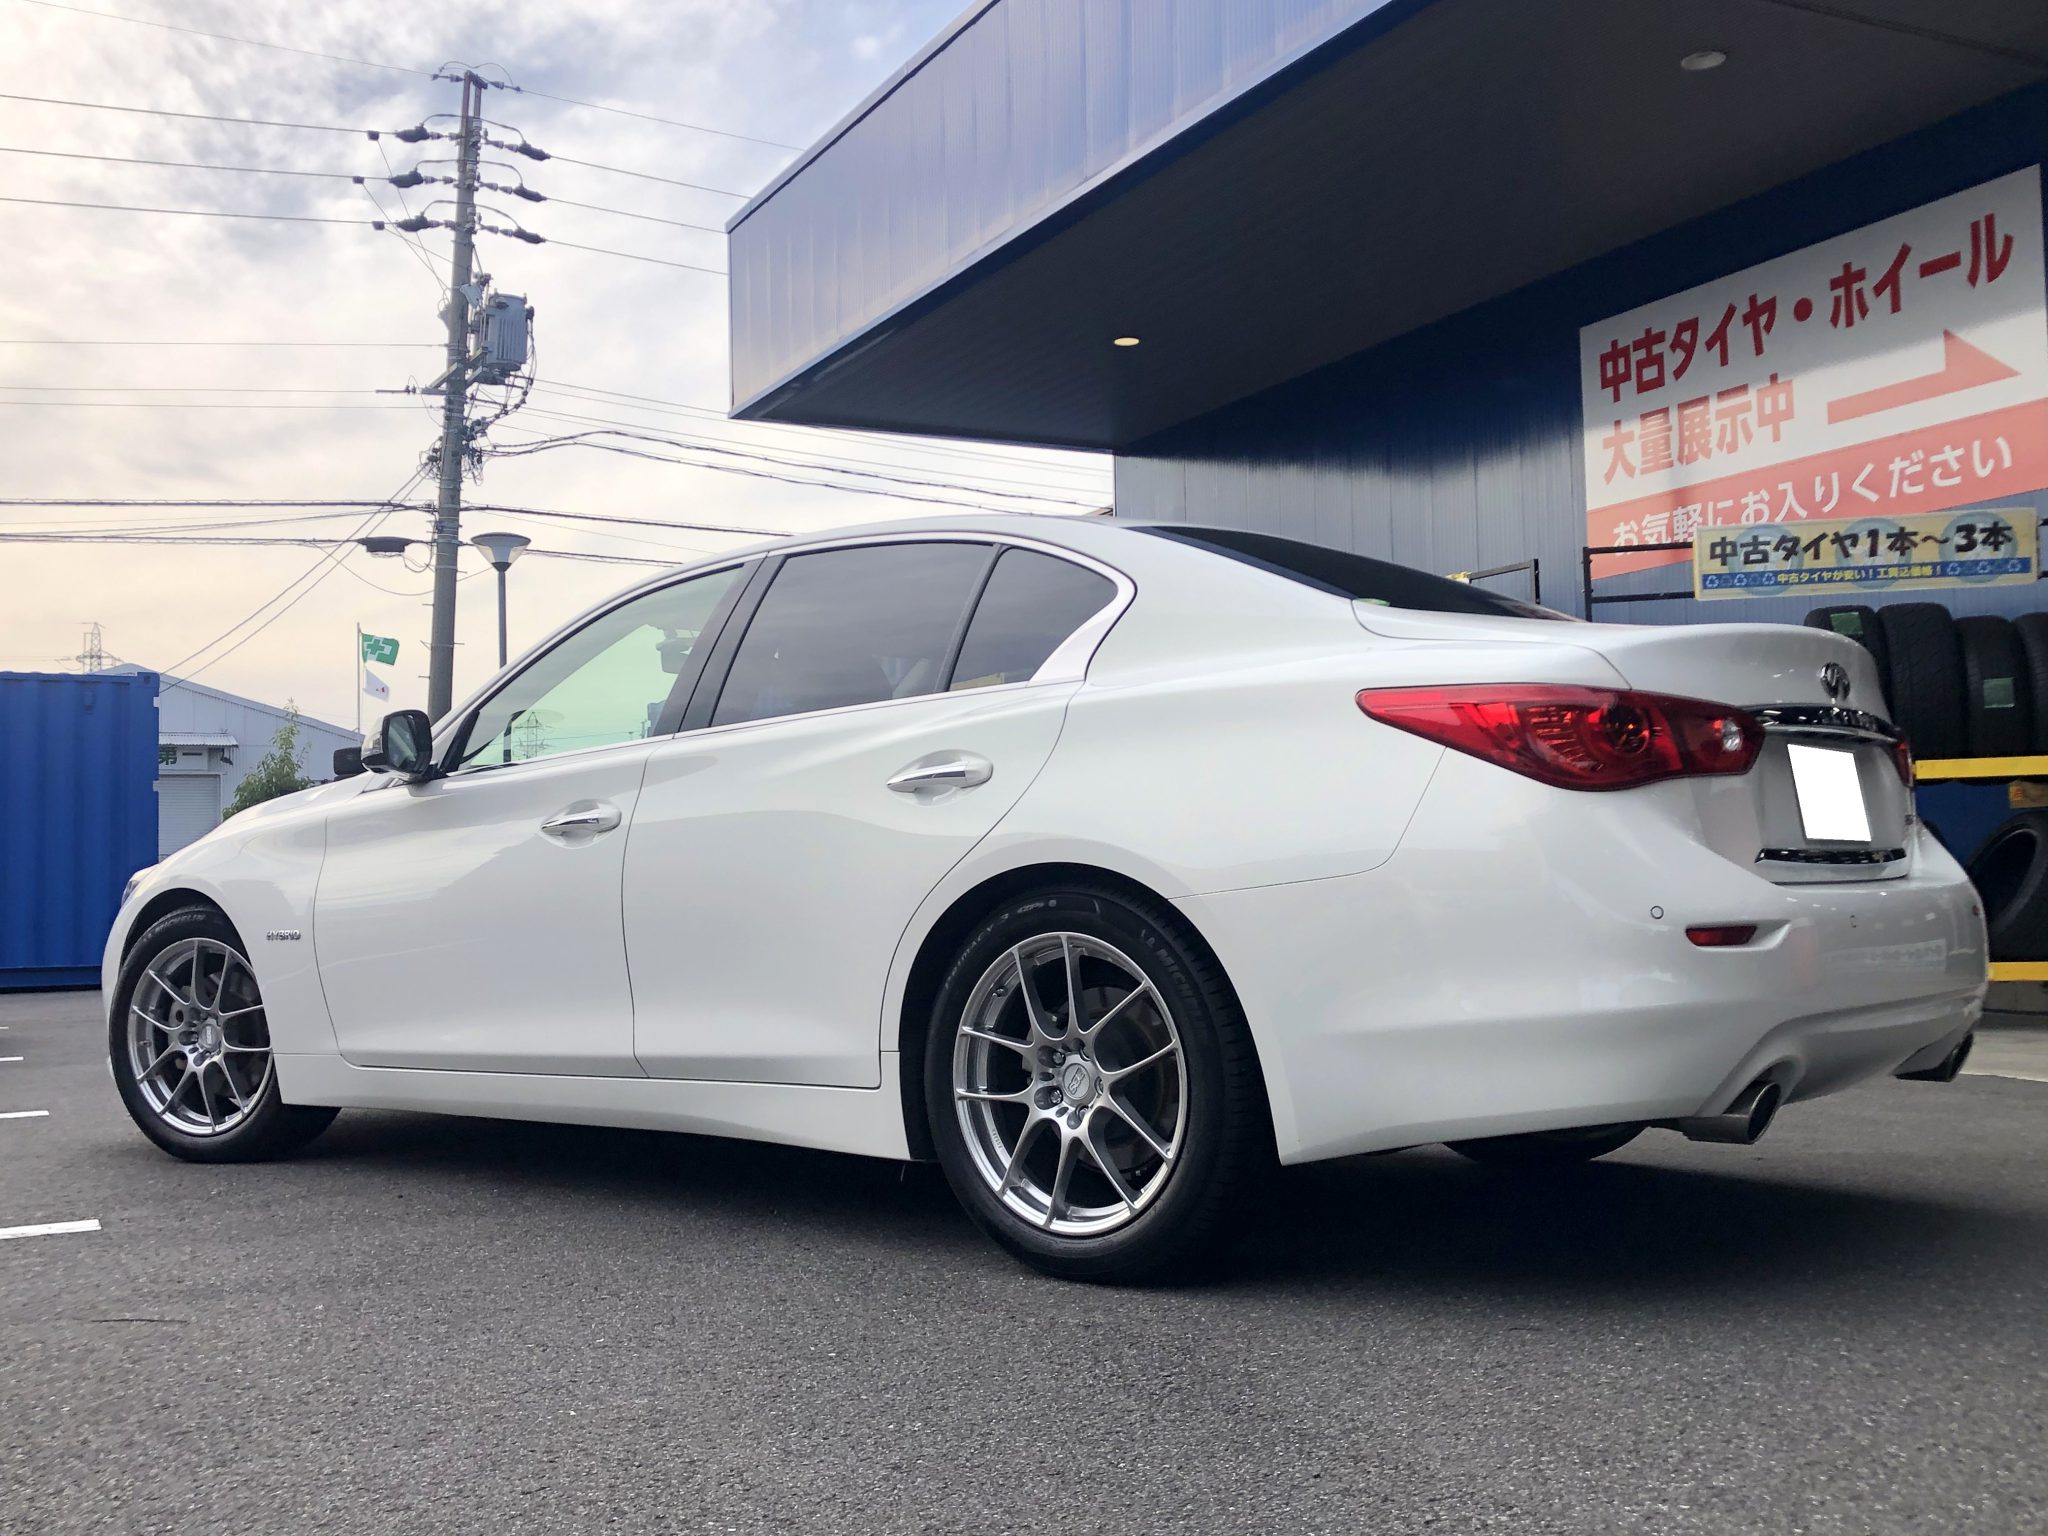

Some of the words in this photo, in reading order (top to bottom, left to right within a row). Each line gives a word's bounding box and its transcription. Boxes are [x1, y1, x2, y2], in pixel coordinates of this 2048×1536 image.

[1600, 213, 2014, 403] 中古タイヤ・ホイール
[1603, 373, 1795, 486] 大量展示中
